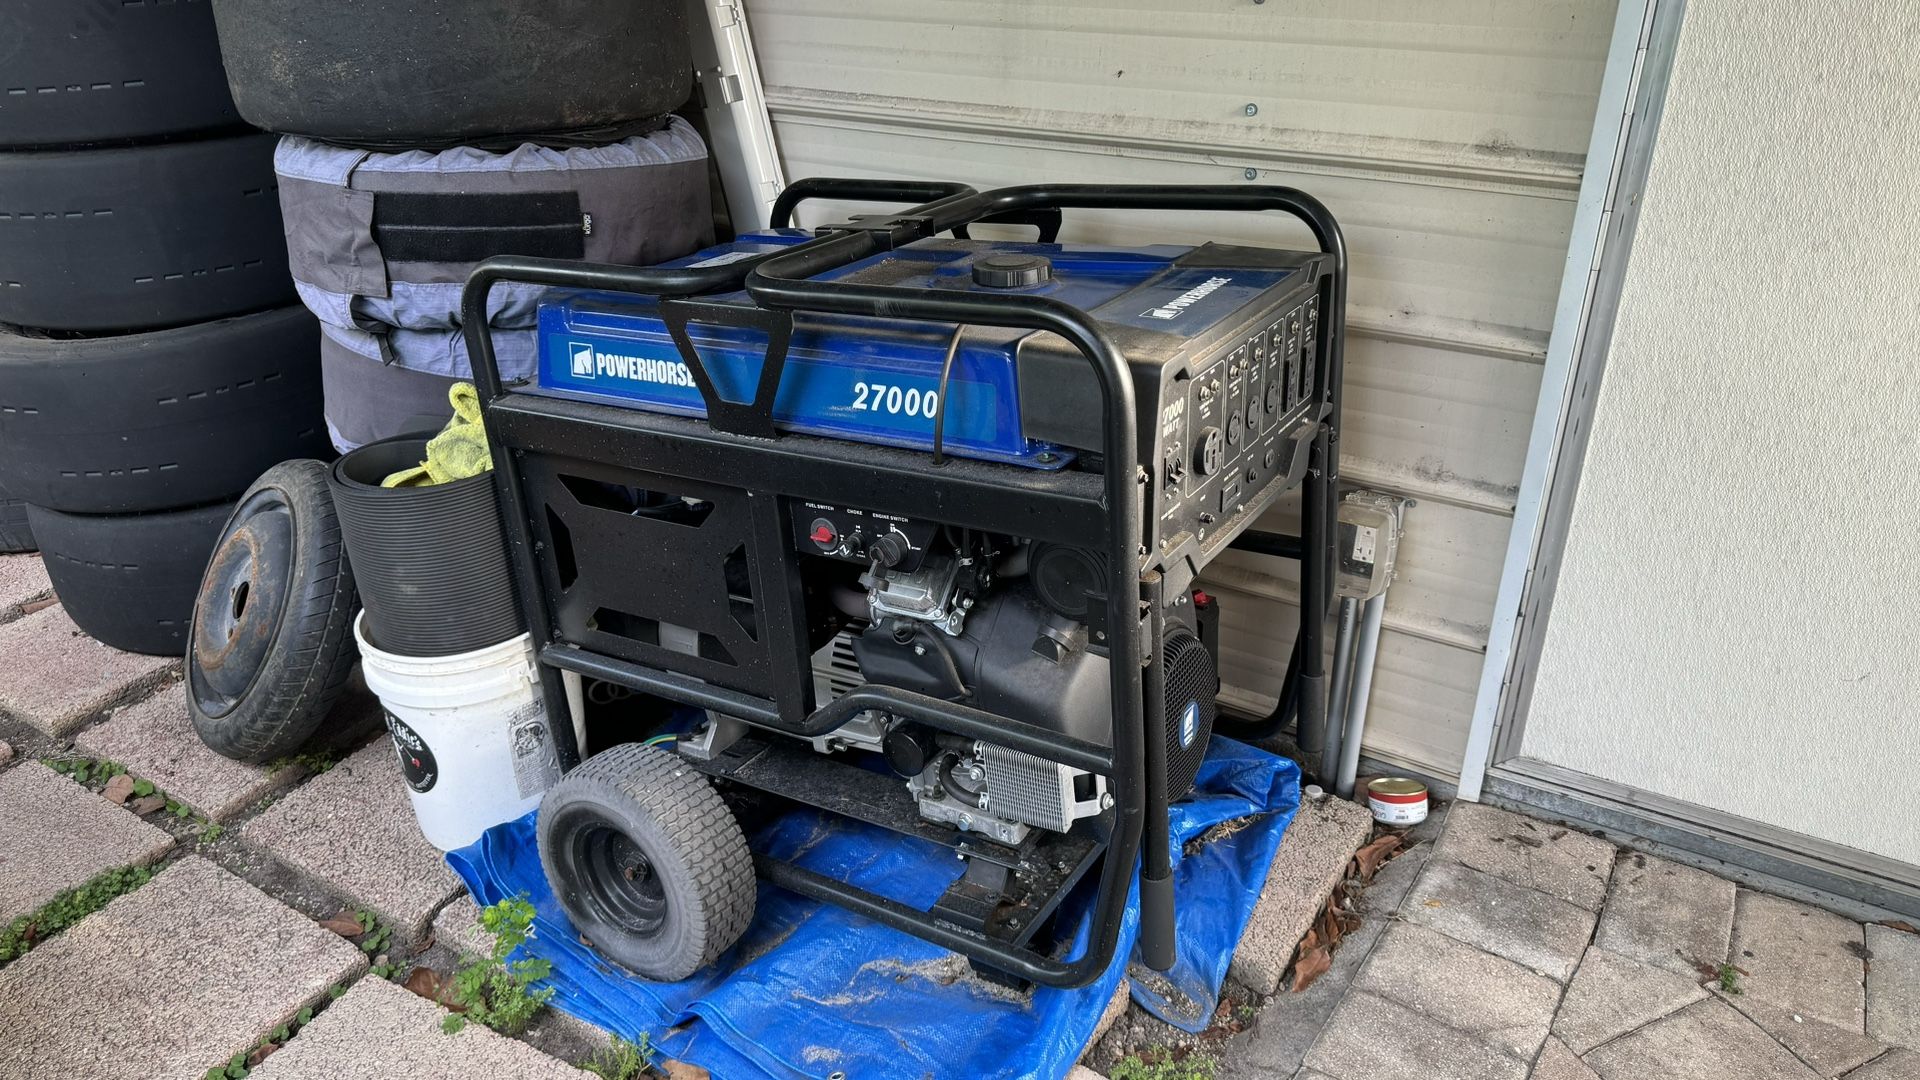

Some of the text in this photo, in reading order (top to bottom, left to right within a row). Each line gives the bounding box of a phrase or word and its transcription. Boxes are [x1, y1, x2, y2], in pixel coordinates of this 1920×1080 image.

[1161, 276, 1233, 310] POWERHORSE
[852, 381, 939, 419] 27000
[1162, 416, 1181, 439] WATT
[817, 503, 835, 511] SWITCH
[846, 508, 863, 516] CHOKE
[872, 512, 909, 523] ENGINE SWITCH
